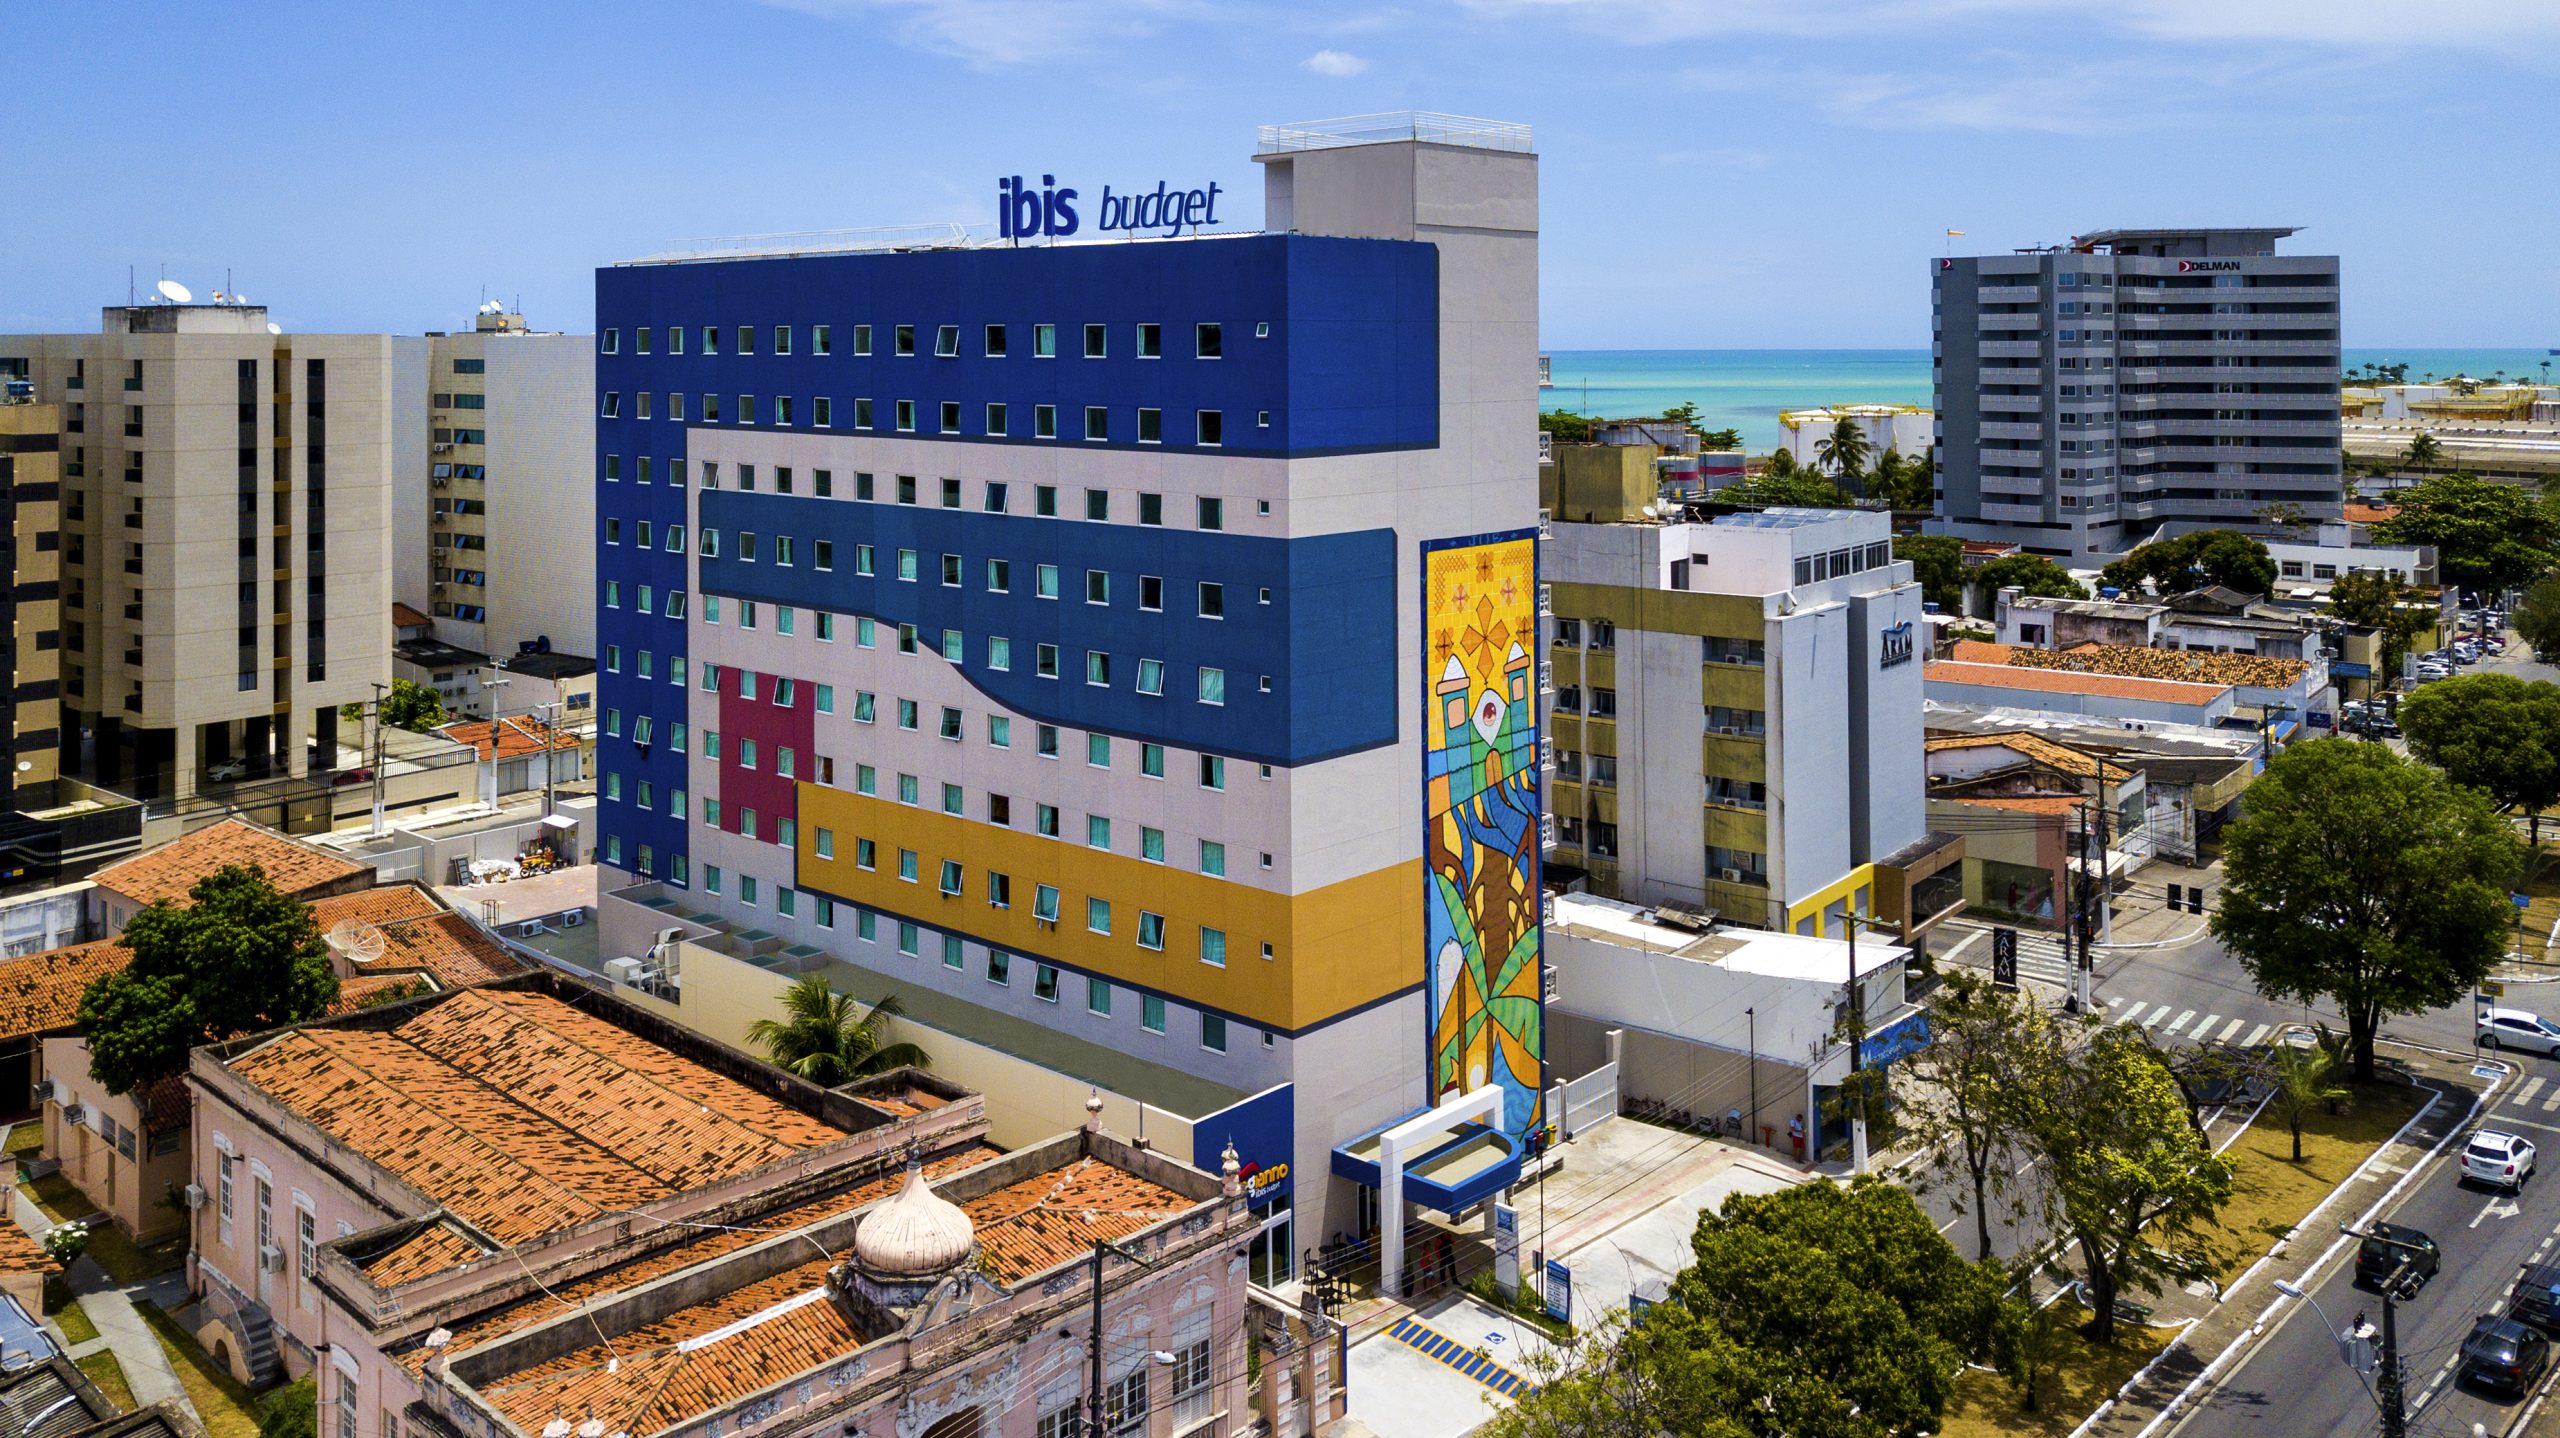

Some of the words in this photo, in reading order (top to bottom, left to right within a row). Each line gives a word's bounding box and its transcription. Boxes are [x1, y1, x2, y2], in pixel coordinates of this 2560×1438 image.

[999, 174, 1079, 238] ibis
[1099, 180, 1223, 238] budget
[2191, 261, 2241, 271] DELMAN
[1881, 633, 1914, 660] ARAM
[1997, 936, 2011, 977] ARAM
